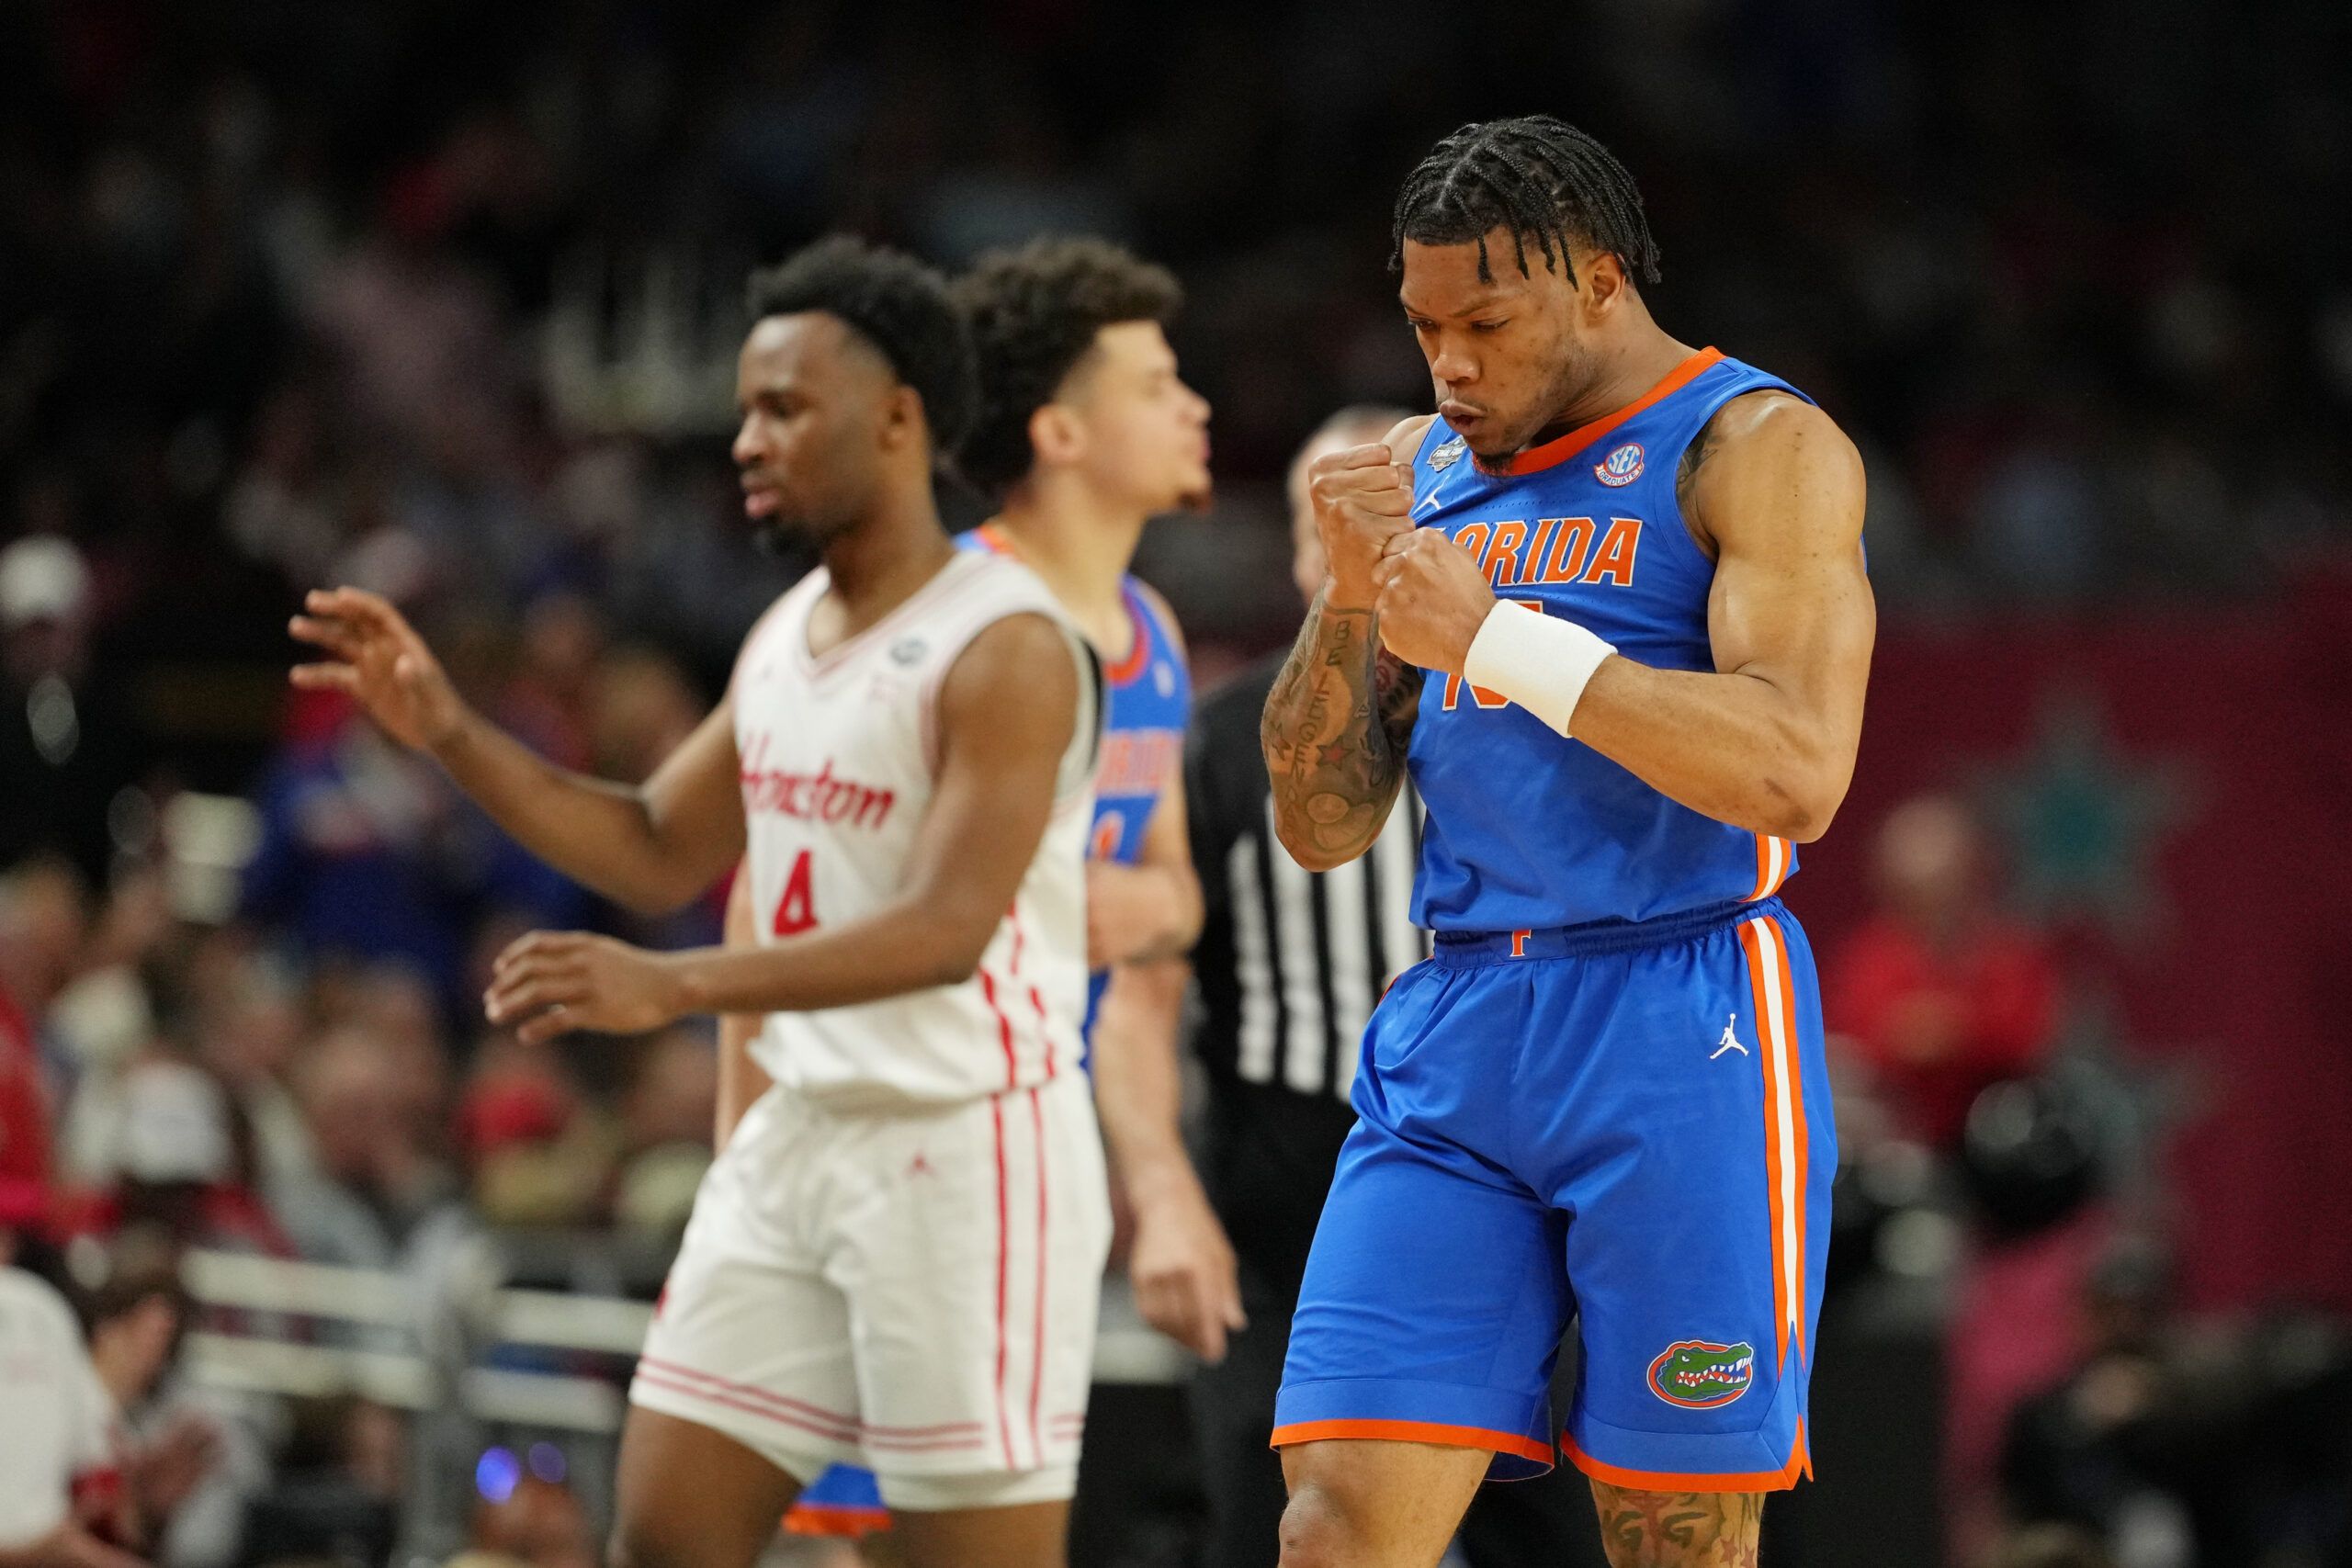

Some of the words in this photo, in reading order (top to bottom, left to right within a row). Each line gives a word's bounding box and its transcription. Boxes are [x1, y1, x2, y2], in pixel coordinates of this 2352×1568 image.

[1599, 470, 1637, 485] GRADUATE
[1609, 446, 1641, 474] SEC
[1435, 517, 1643, 587] ORIDA
[774, 849, 819, 935] 4
